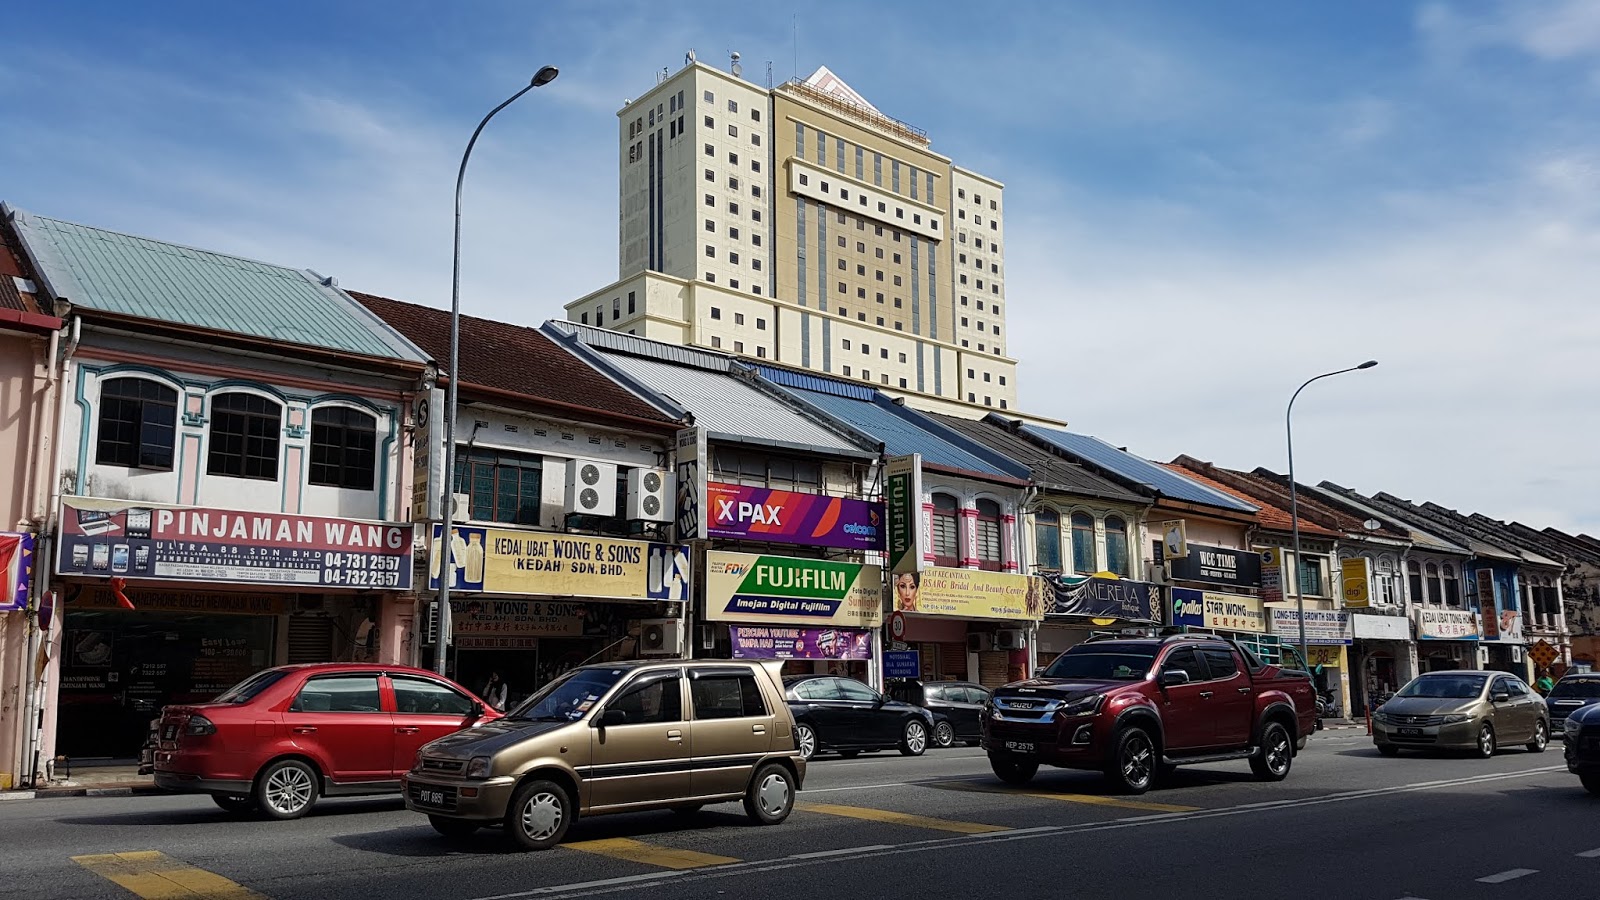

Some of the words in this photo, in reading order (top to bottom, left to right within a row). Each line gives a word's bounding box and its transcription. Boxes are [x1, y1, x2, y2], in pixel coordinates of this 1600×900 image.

[893, 476, 905, 552] FUJIFILM
[157, 509, 313, 543] PINJAMAN
[325, 522, 402, 549] WANG
[843, 522, 876, 535] celcom
[156, 541, 208, 552] ULTRA
[221, 546, 238, 554] 88
[250, 548, 280, 556] SDN
[293, 550, 321, 558] BHD
[495, 537, 522, 556] KEDAI
[527, 540, 549, 558] UBAT
[553, 540, 590, 560] WONG
[595, 543, 604, 562] &
[608, 545, 641, 564] SONS
[156, 555, 199, 563] PEMBERI
[206, 558, 240, 566] PINJAM
[325, 552, 367, 569] 04-731
[370, 555, 400, 571] 2557
[1200, 551, 1215, 567] WCC
[1216, 553, 1236, 568] TIME
[513, 558, 565, 572] (KEDAH)
[571, 562, 598, 575] SDN.
[600, 564, 626, 576] BHD.
[324, 569, 367, 584] 04-732
[369, 571, 400, 586] 2557
[756, 565, 845, 591] FUJIFILM
[862, 588, 878, 596] Digital
[950, 581, 969, 591] Bridal
[972, 584, 984, 592] And
[985, 584, 1005, 596] Beauty
[1005, 585, 1025, 595] Centre
[494, 602, 528, 615] WONG
[737, 599, 767, 609] Imejan
[770, 600, 798, 611] Digital
[801, 602, 830, 612] Fujifilm
[848, 595, 878, 609] Sunlight
[1206, 600, 1225, 615] STAR
[1226, 603, 1247, 617] WONG
[1274, 610, 1302, 620] LONG-TER
[1305, 611, 1325, 621] GROWTH
[1422, 612, 1436, 623] KEDAI
[1437, 612, 1449, 623] UBAT
[1449, 613, 1462, 624] TONG
[894, 620, 901, 630] 30
[738, 627, 769, 638] PERCUMA
[770, 628, 800, 638] YOUTUBE
[738, 639, 759, 648] TANPA
[760, 639, 774, 649] HAD
[1018, 742, 1034, 750] 2575
